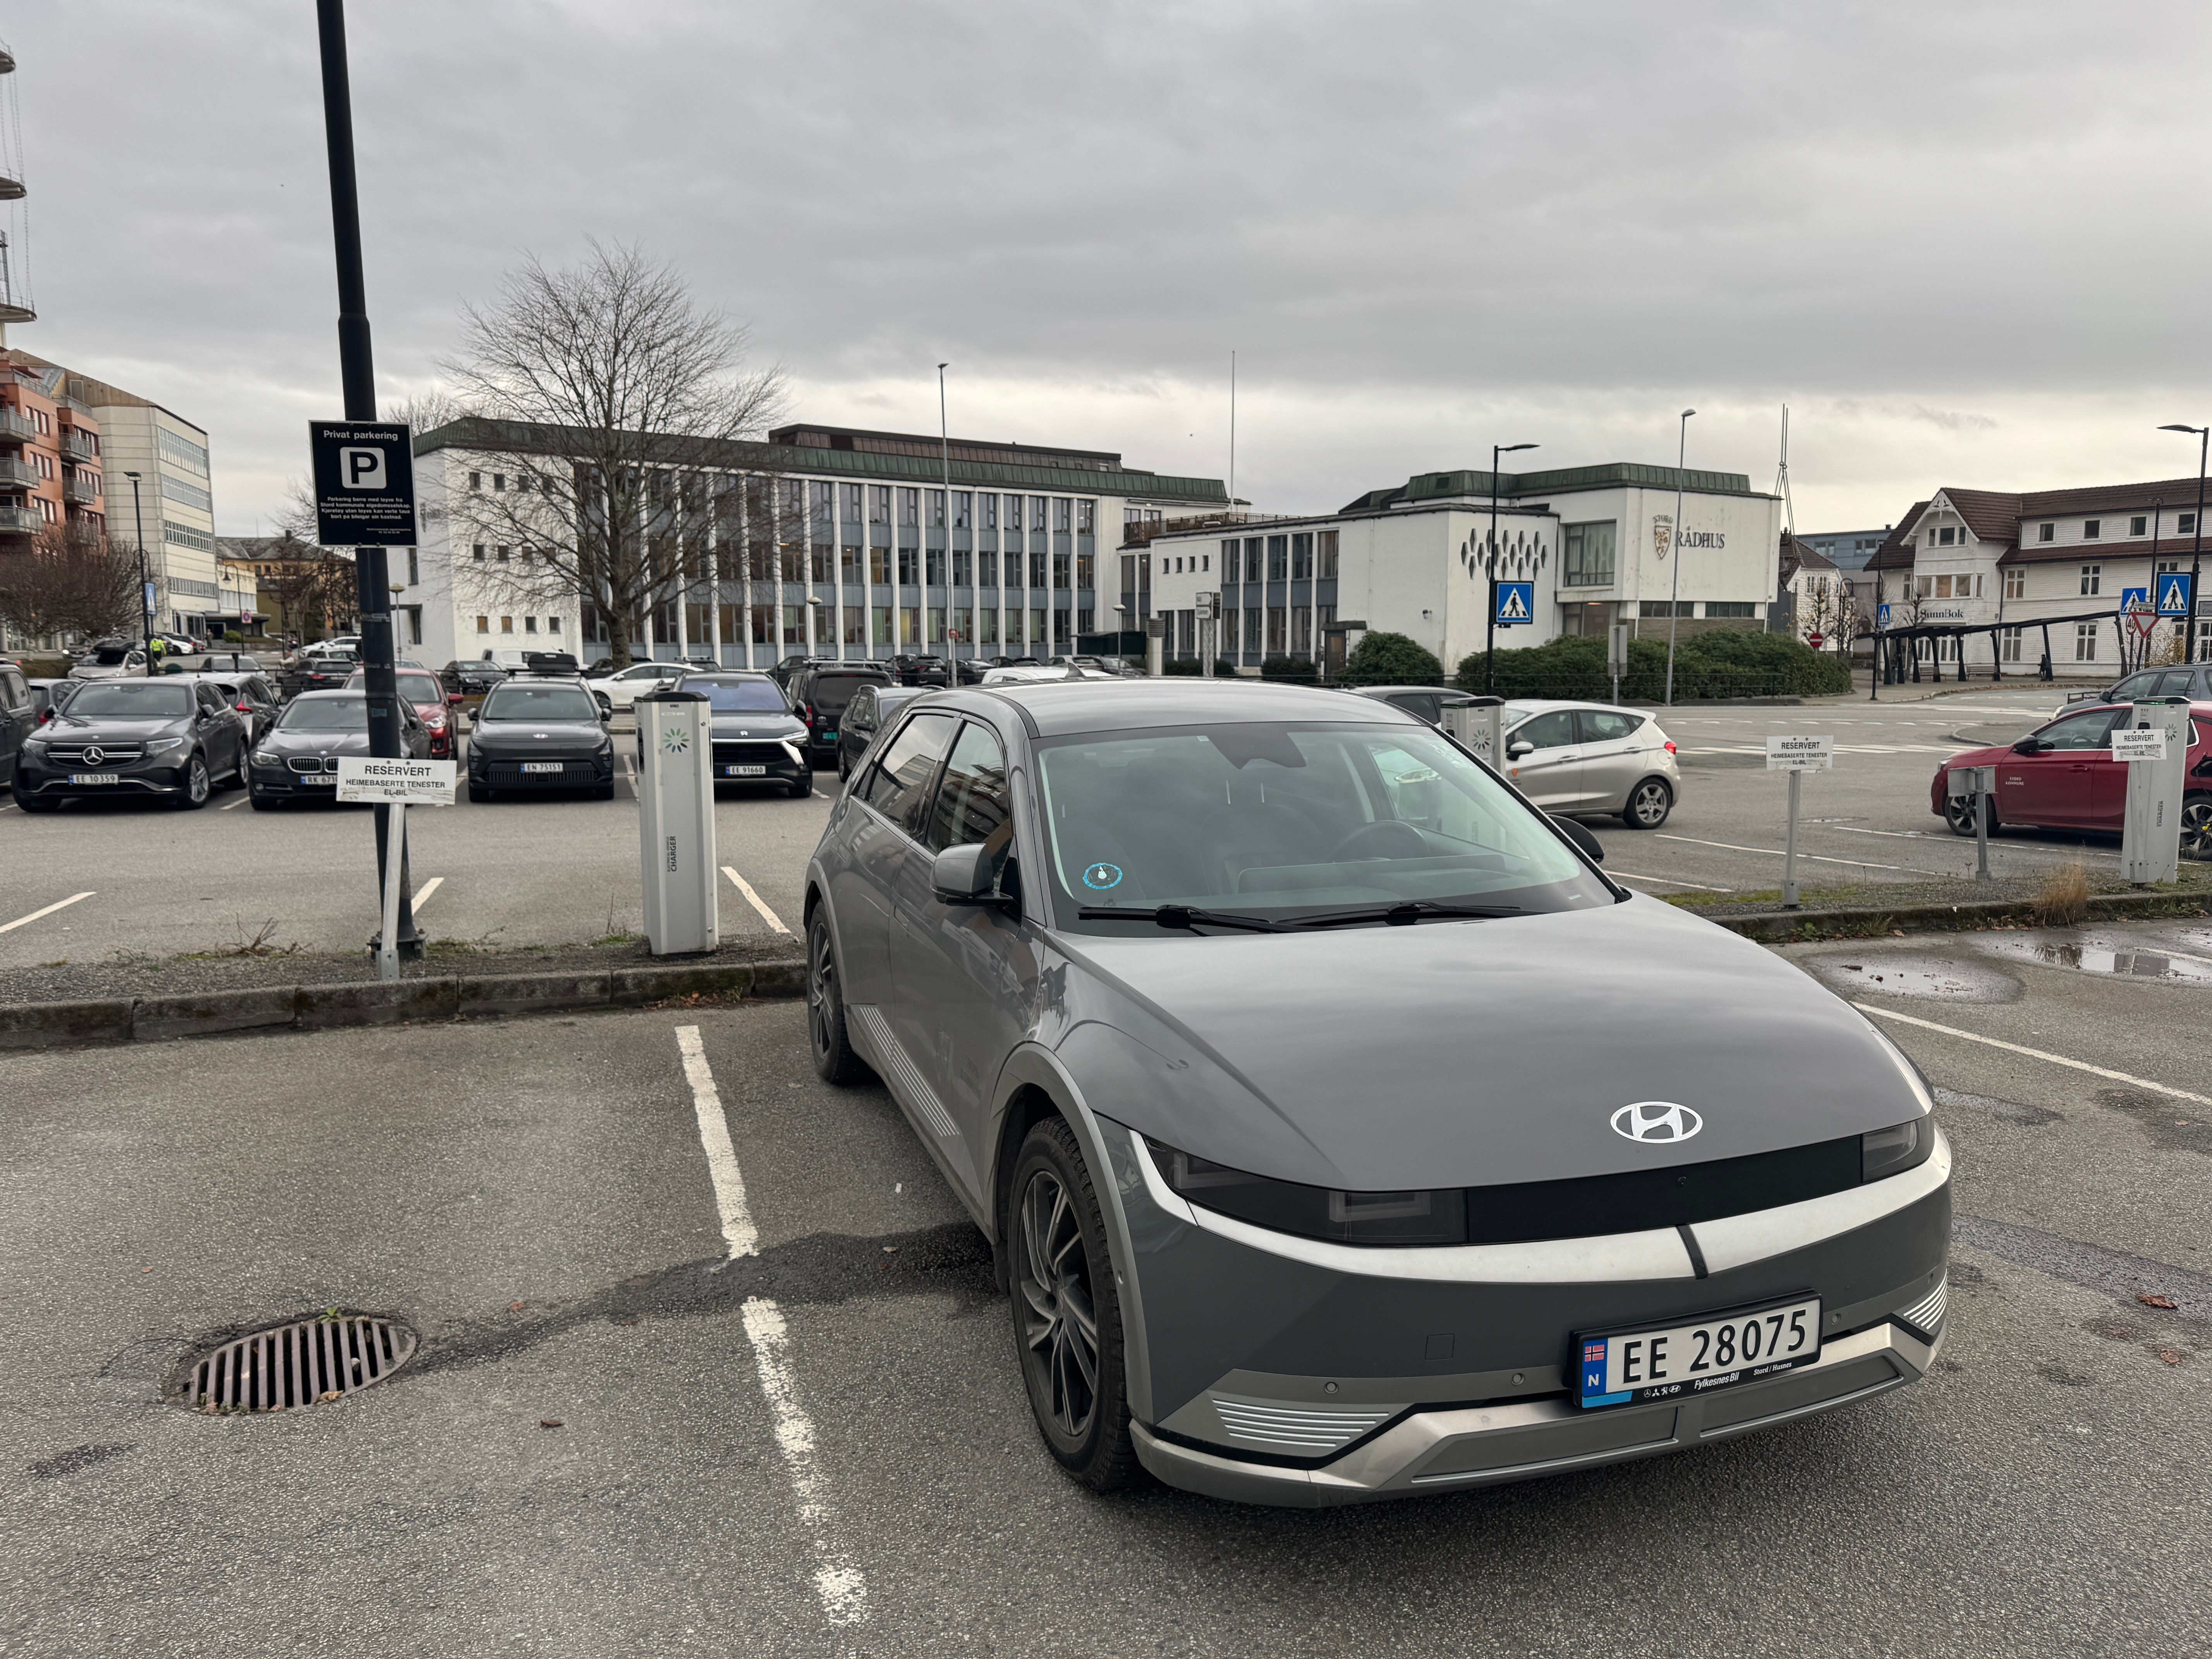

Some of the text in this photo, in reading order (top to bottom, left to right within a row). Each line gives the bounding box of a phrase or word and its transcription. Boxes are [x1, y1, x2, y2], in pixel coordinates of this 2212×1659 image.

[323, 430, 398, 441] Privat parkering
[349, 451, 378, 484] P
[1674, 526, 1725, 549] RÅDHUS
[1781, 742, 1820, 750] RESERVERT
[365, 765, 431, 776] RESERVERT
[346, 779, 405, 787] HEIMEBASERTE
[1623, 1309, 1807, 1384] EE 28075
[1772, 1362, 1792, 1371] Husnes
[1588, 1374, 1599, 1387] N
[1694, 1372, 1740, 1390] Fylkesnes Bil
